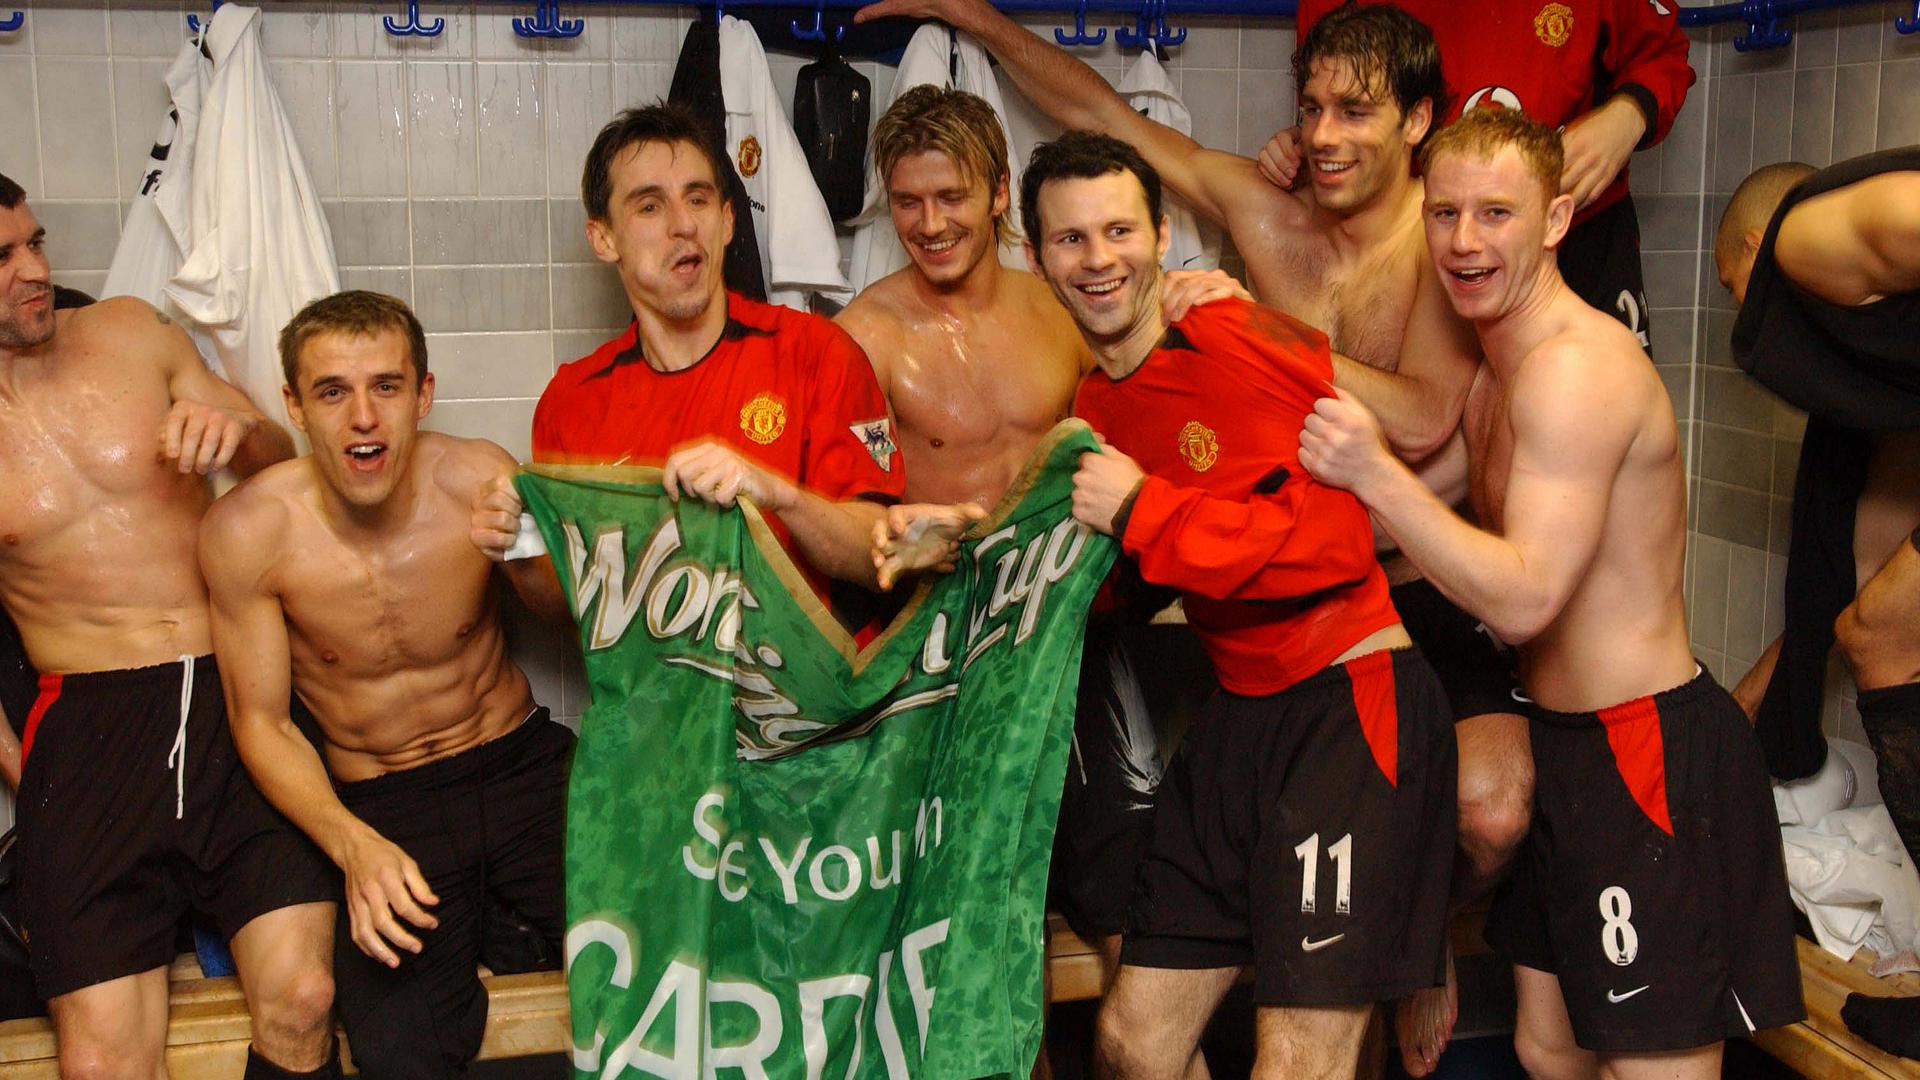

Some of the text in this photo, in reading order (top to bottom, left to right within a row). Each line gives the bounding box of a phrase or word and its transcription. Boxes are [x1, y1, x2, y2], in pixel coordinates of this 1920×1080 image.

[966, 517, 1091, 647] Cup
[1294, 832, 1352, 916] 11
[1599, 885, 1639, 967] 8
